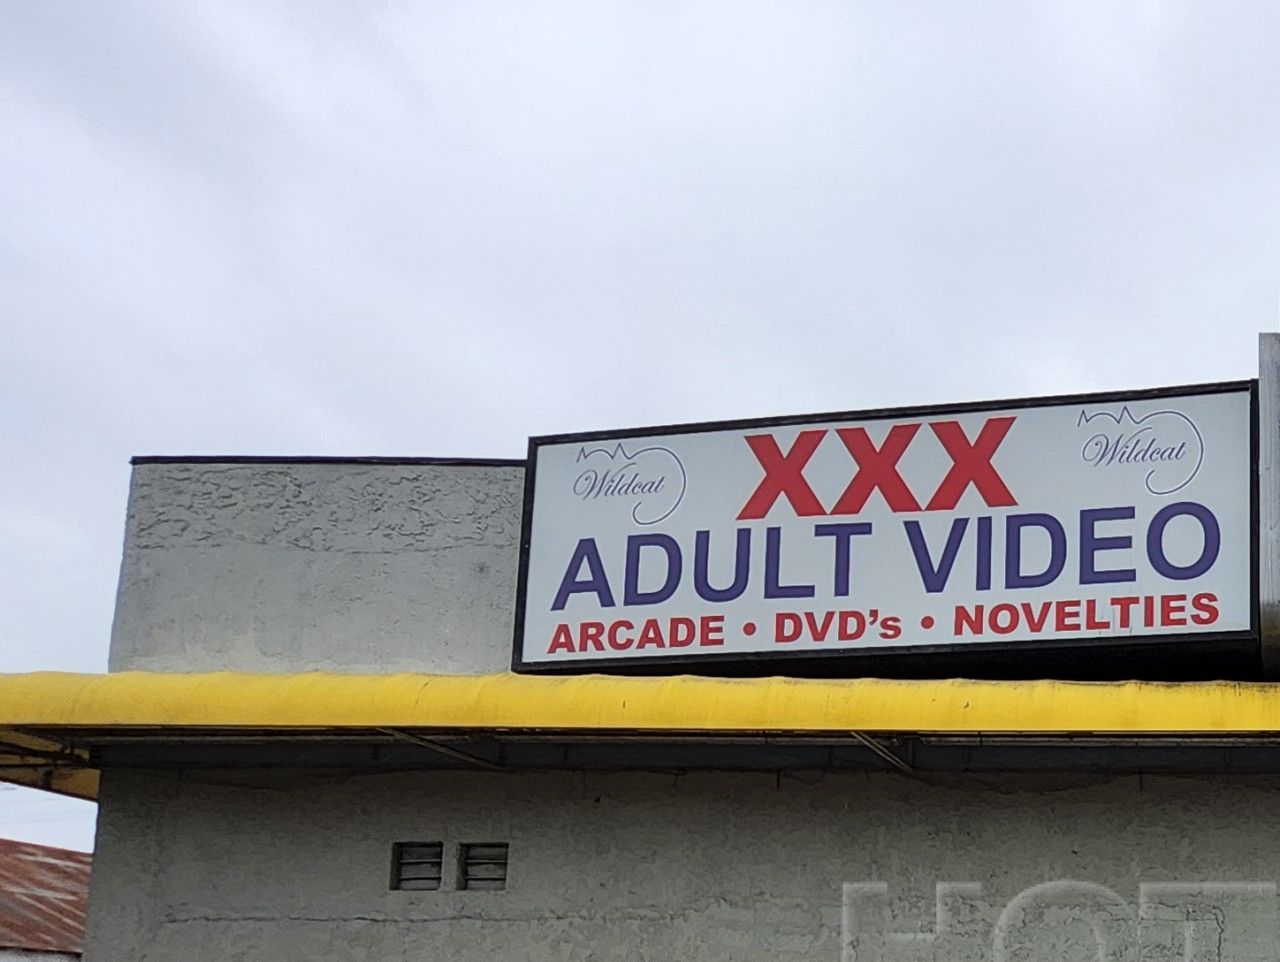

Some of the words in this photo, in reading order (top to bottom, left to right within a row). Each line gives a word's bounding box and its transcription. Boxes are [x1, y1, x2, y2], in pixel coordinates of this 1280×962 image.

[737, 416, 1018, 520] XXX
[1082, 426, 1186, 467] Wildcat
[573, 461, 666, 501] Wildcat
[550, 522, 873, 611] ADULT
[904, 501, 1222, 594] VIDEO
[547, 615, 725, 654] ARCADE
[774, 610, 902, 644] DVD's
[954, 592, 1220, 637] NOVELTIES
